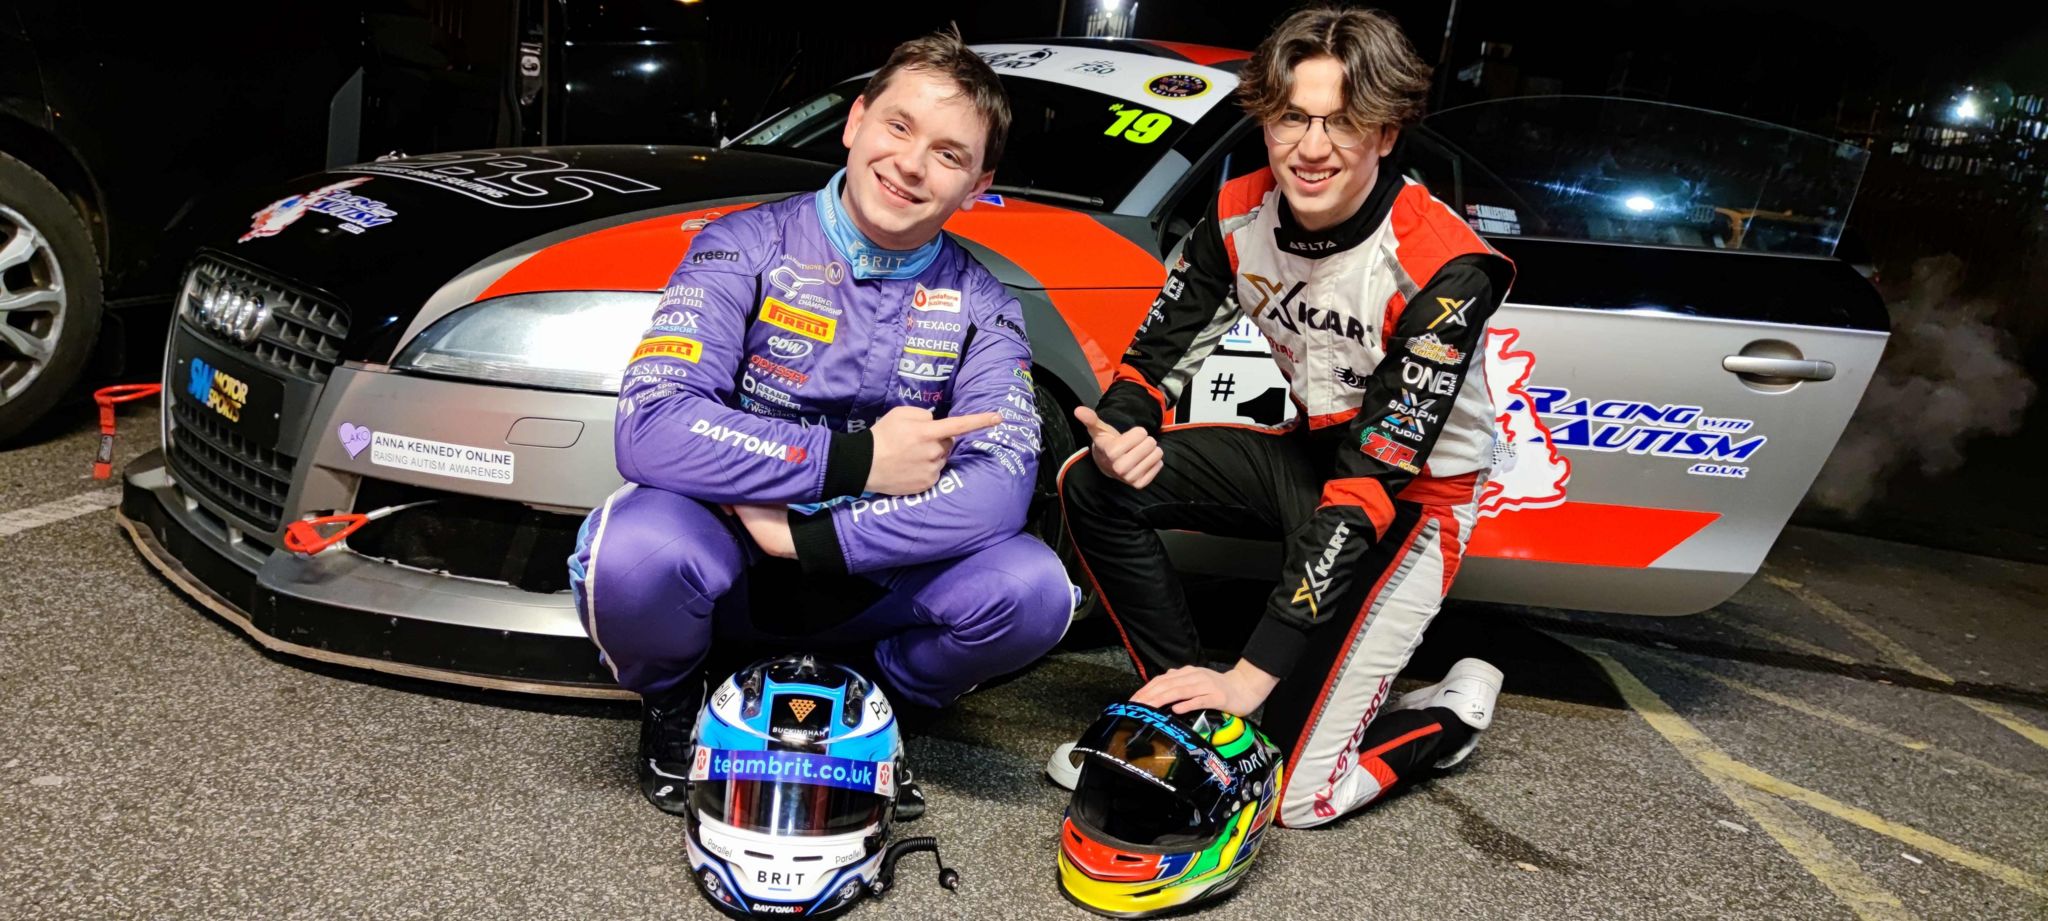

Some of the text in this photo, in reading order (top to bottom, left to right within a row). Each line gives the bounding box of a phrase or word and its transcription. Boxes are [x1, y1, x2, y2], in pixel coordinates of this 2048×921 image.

[859, 254, 905, 270] BRIT
[681, 296, 703, 308] Inn
[768, 303, 829, 337] PIRELLI
[916, 319, 961, 333] TEXACO
[767, 335, 804, 354] CDW
[750, 354, 809, 384] ODYSSEY
[899, 358, 954, 377] DAF
[214, 369, 249, 405] MOTOR
[1388, 399, 1439, 424] GRAPH
[1506, 387, 1751, 430] RACING WITH
[690, 419, 788, 461] DAYTONA
[1380, 420, 1424, 441] STUDIO
[1528, 419, 1765, 460] AUTISM
[374, 435, 512, 466] ANNA KENNEDY ONLINE
[373, 451, 512, 480] RAISING AUTISM AWARENESS
[772, 726, 826, 737] BUCKINGHAM
[713, 755, 872, 786] teambrit.co.uk
[707, 837, 733, 858] Parallel
[834, 847, 862, 865] Parallel
[757, 870, 805, 886] BRIT
[753, 903, 796, 914] DAYTONA
